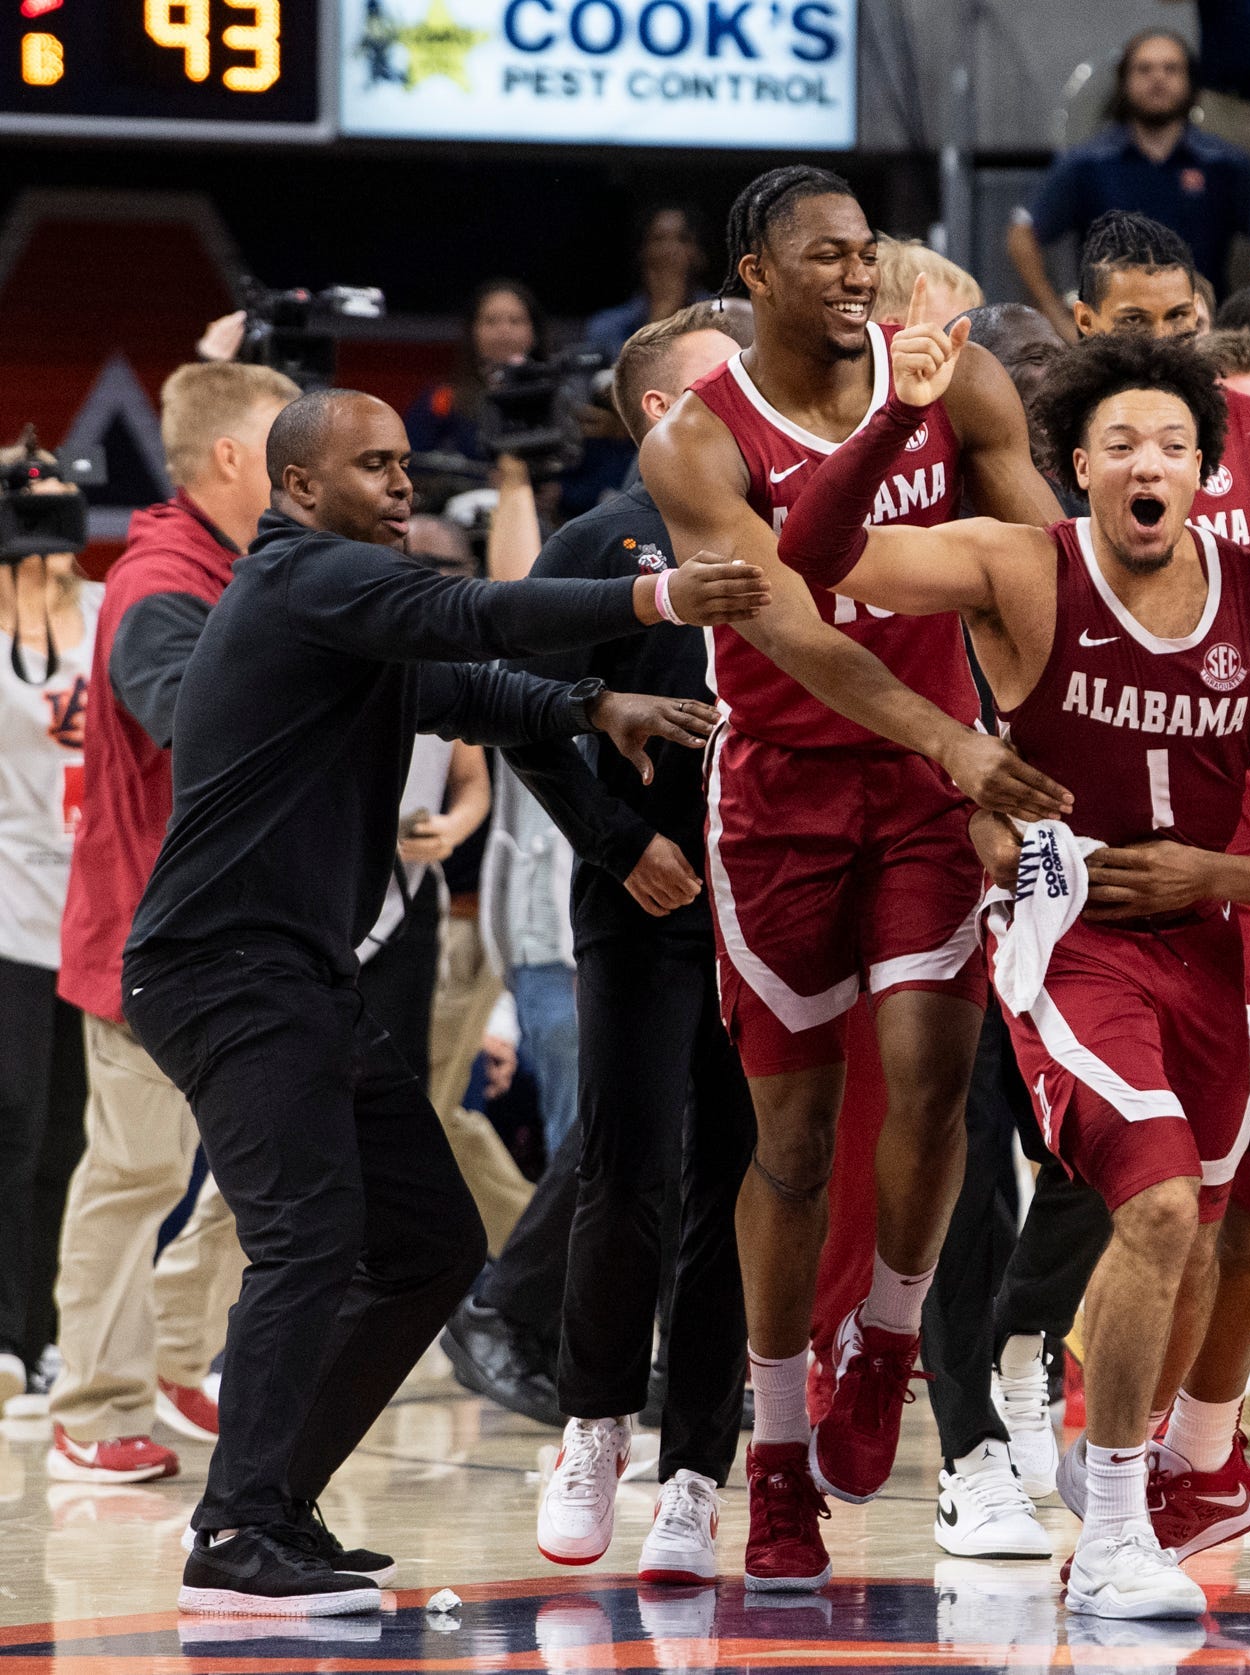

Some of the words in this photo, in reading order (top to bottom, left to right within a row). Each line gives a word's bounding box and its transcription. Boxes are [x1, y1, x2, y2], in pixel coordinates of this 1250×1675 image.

[144, 0, 280, 92] 93
[504, 0, 838, 62] COOK'S
[503, 65, 606, 97] PEST
[627, 70, 839, 106] CONTROL
[1207, 645, 1238, 679] SEC
[1062, 671, 1249, 737] ALABAMA
[1146, 748, 1175, 831] 1
